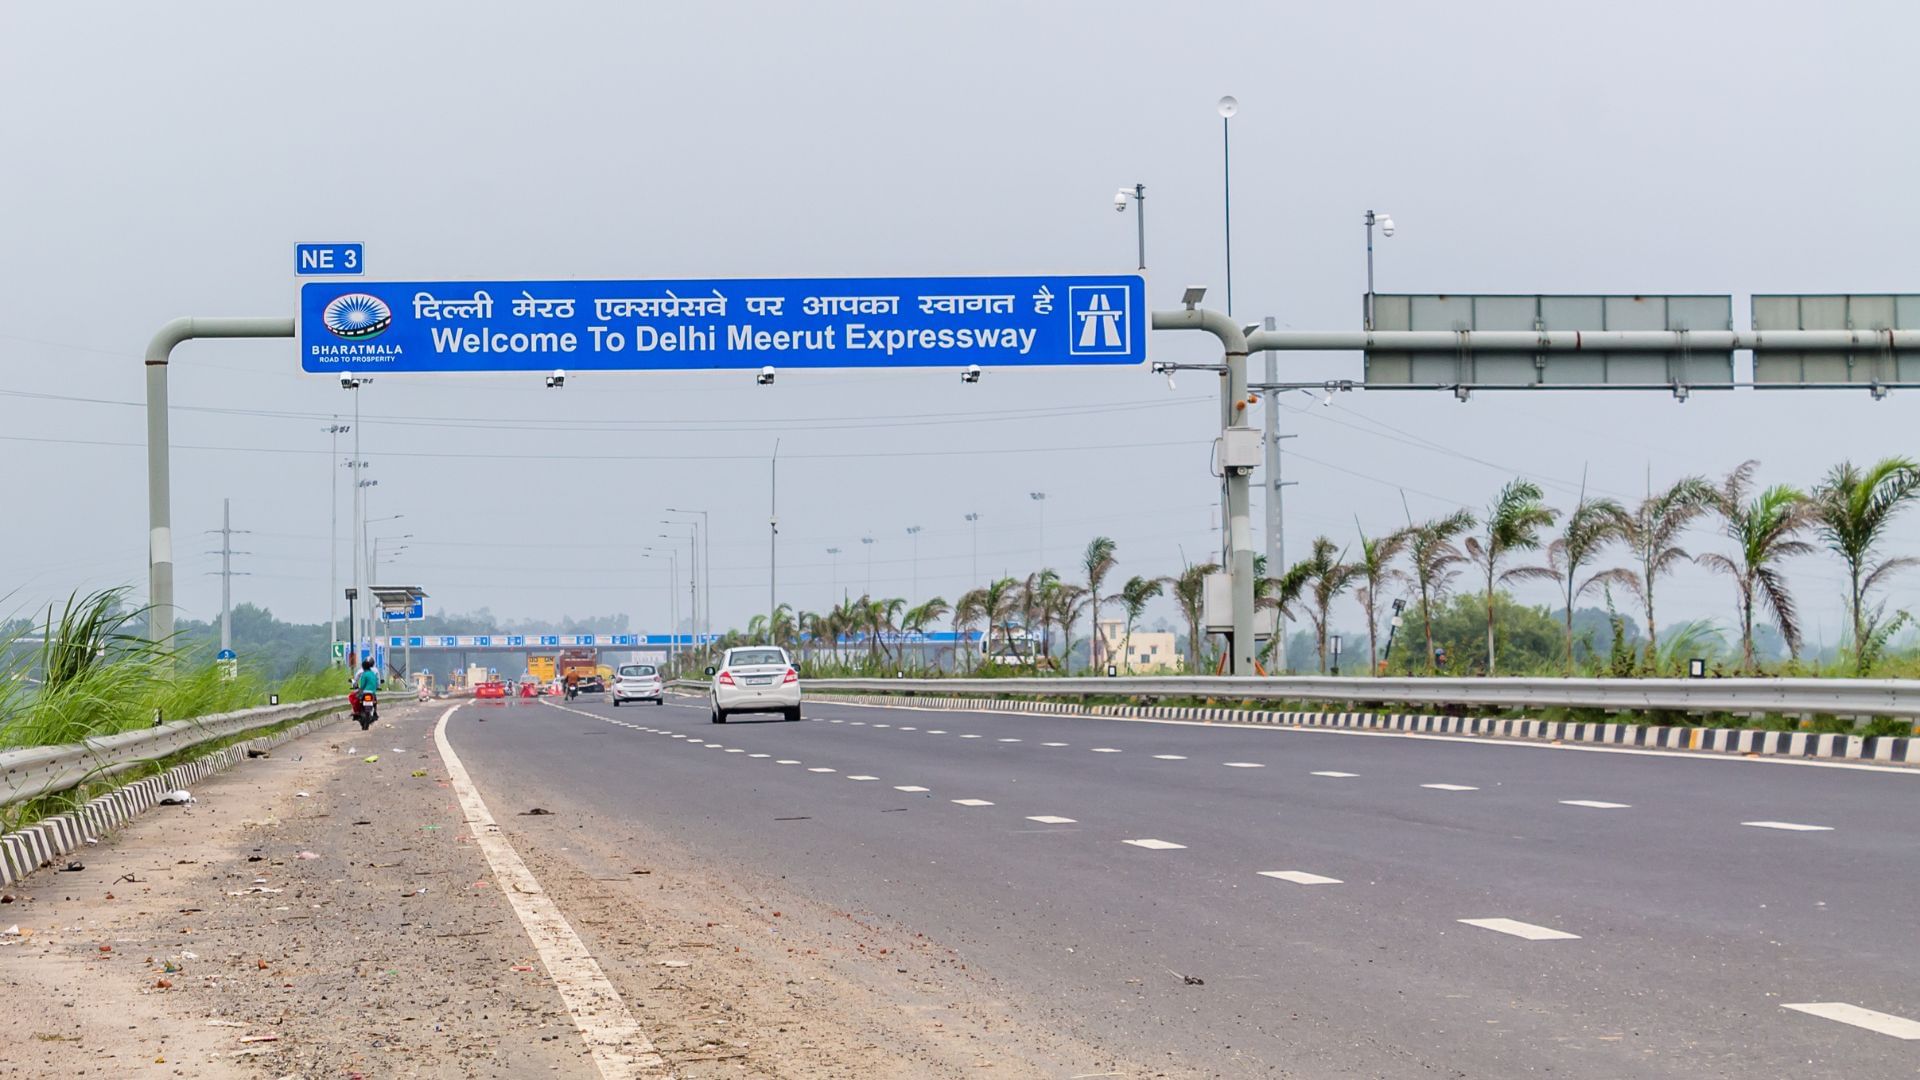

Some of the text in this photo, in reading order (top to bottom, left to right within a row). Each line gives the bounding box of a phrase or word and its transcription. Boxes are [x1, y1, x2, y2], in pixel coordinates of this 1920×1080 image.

[302, 249, 357, 269] NE 3
[412, 284, 1055, 320] दिल्ली मेरठ एक्सप्रेसवे पर आपका स्वागत है
[311, 345, 403, 355] BHARATMALA
[431, 323, 1037, 356] Welcome To Delhi Meerut Expressway
